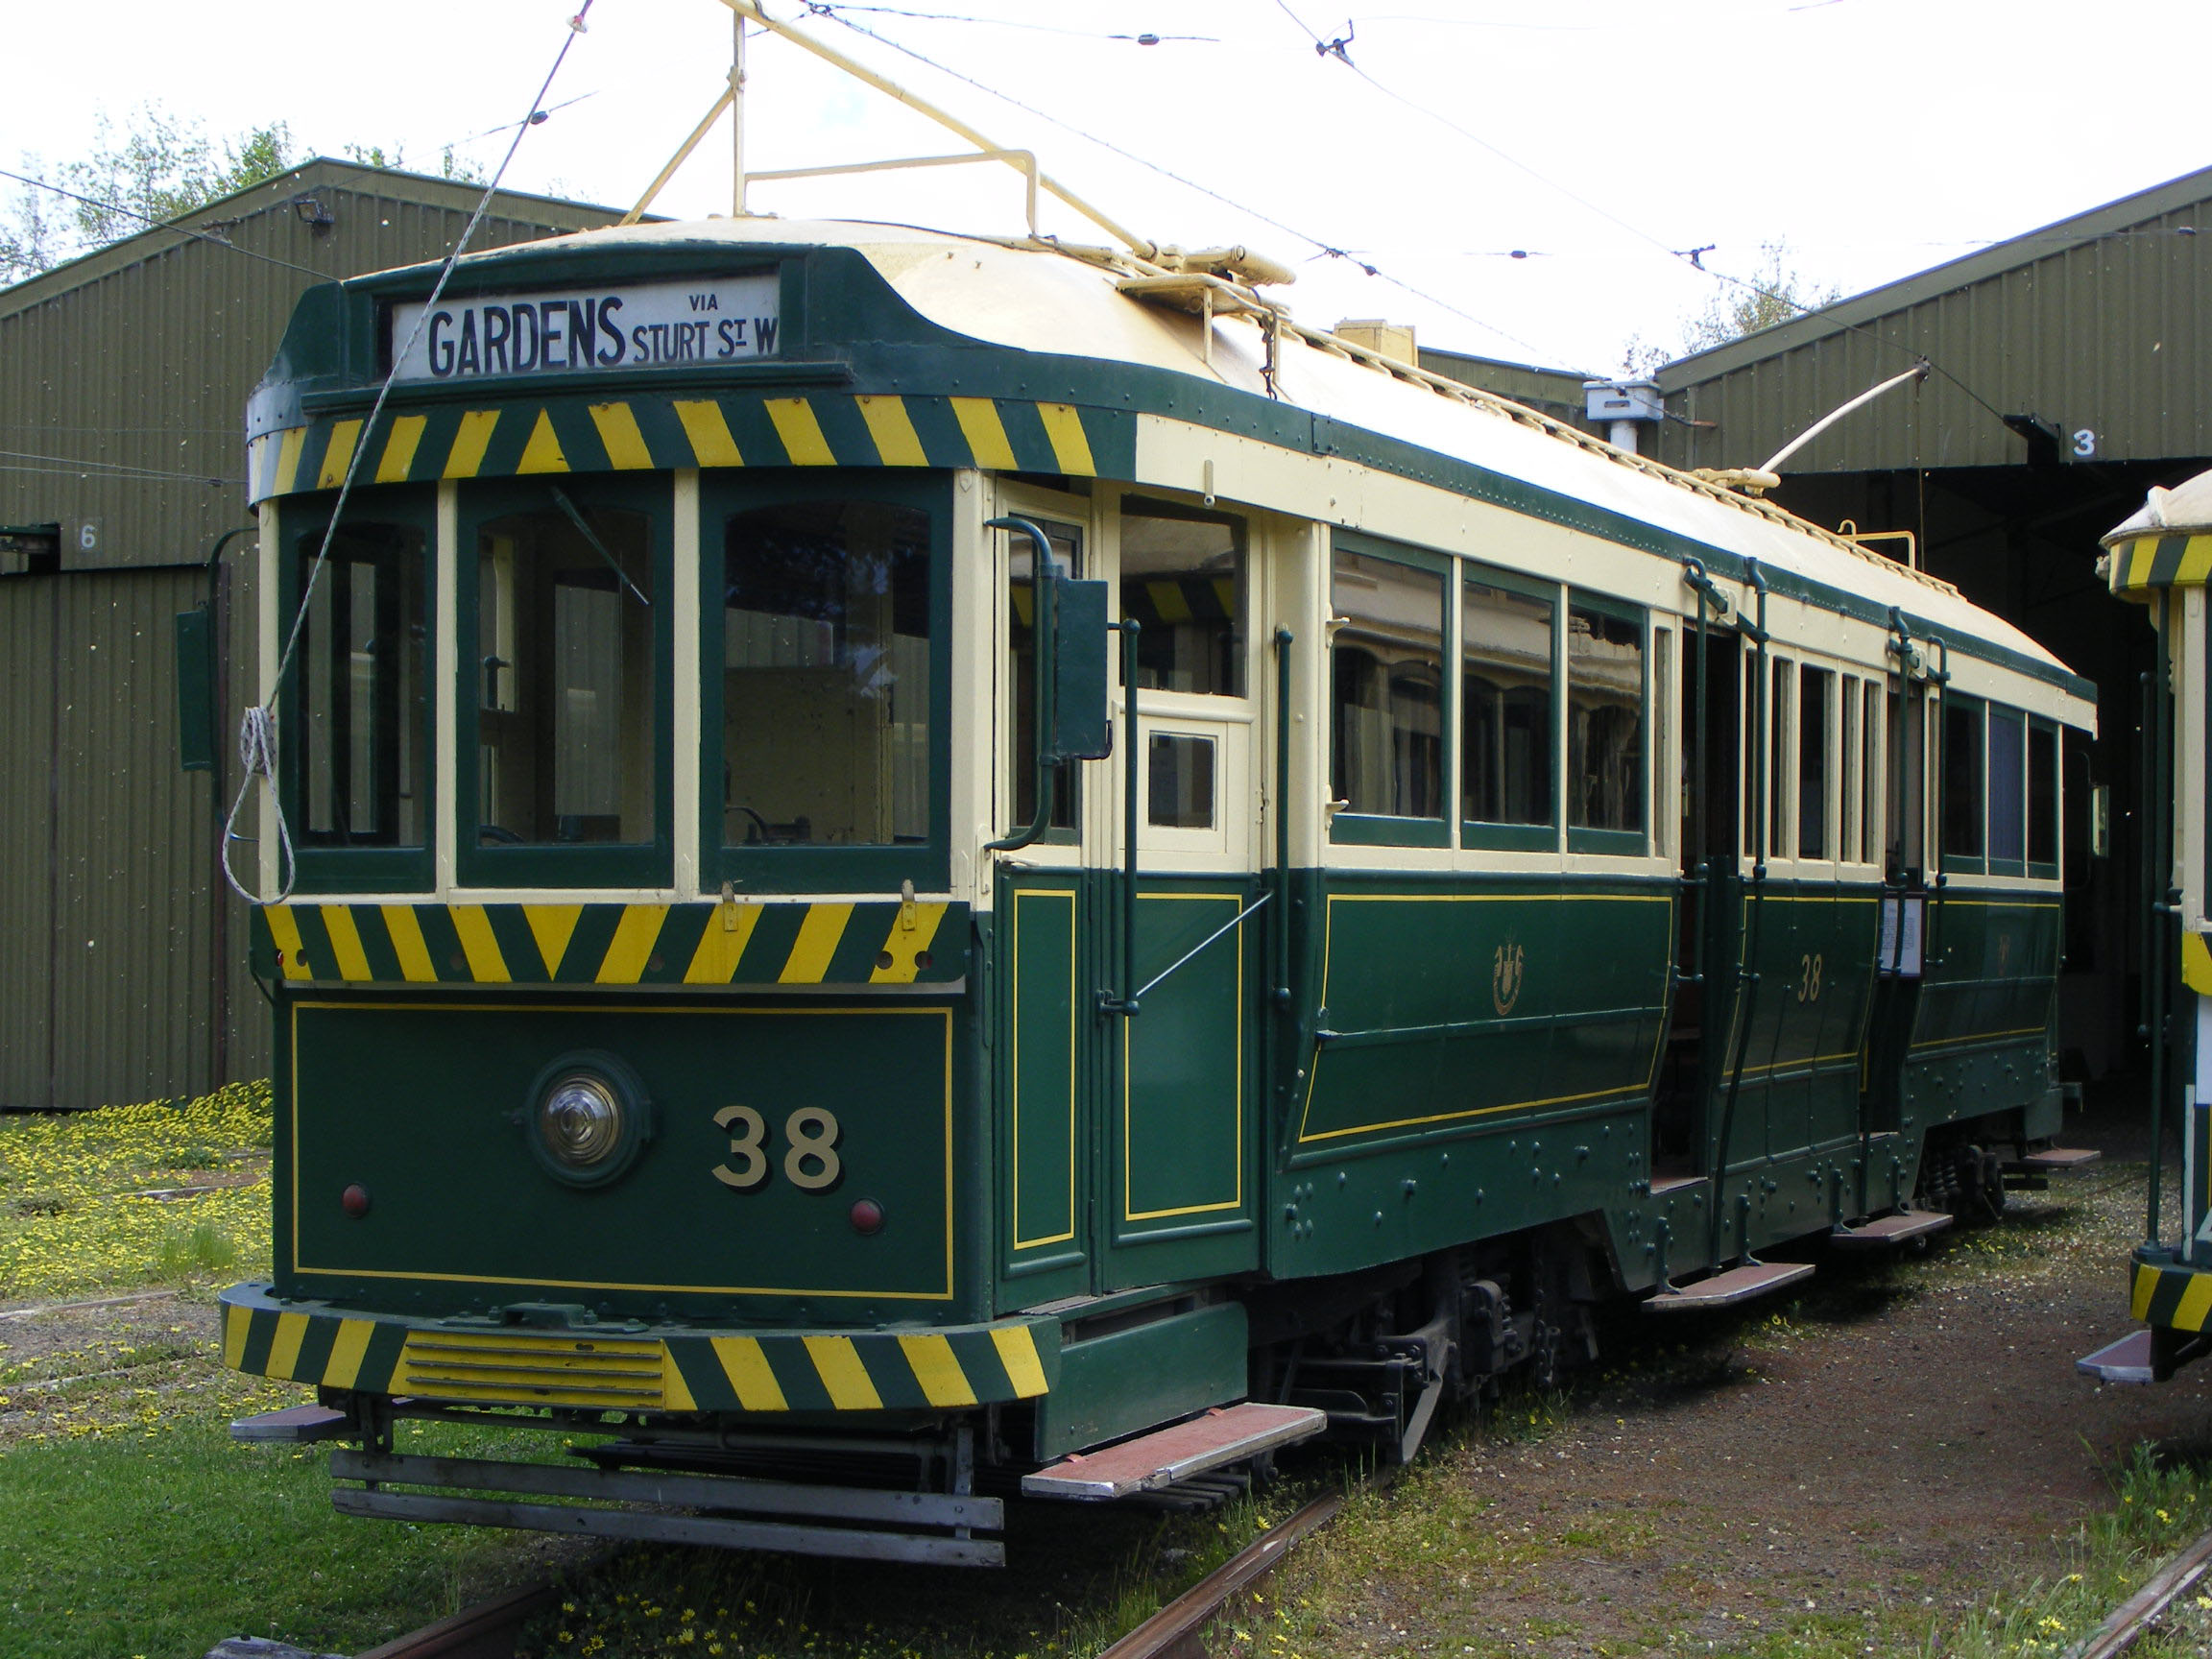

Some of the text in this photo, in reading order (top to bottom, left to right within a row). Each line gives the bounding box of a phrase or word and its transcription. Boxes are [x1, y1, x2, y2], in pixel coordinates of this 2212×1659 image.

[688, 293, 718, 312] VIA
[428, 295, 626, 378] GARDENS
[632, 320, 710, 363] STURT
[754, 316, 779, 355] W
[2073, 428, 2096, 457] 3
[81, 523, 97, 549] 6
[1797, 953, 1822, 1002] 38
[711, 1105, 841, 1190] 38
